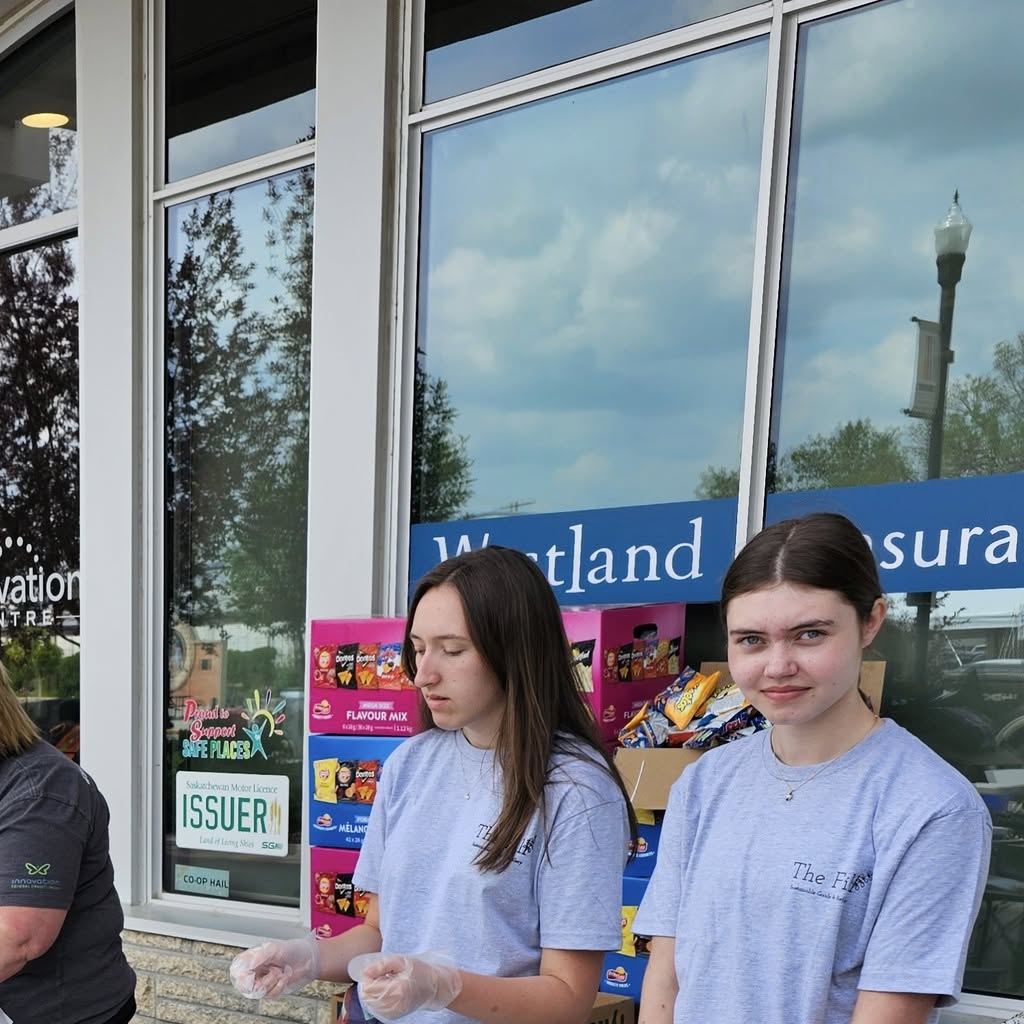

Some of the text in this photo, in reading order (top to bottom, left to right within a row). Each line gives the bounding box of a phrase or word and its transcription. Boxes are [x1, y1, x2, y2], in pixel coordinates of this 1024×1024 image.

[433, 517, 703, 593] Wtland
[863, 524, 1018, 570] sura
[184, 699, 230, 722] Proud to
[346, 711, 408, 721] FLAVOUR MIX
[190, 719, 236, 742] Support
[182, 739, 251, 760] SAFE PLACES
[186, 781, 278, 794] Saskatchewan Motor Licence
[183, 794, 267, 834] ISSUER
[183, 874, 229, 889] CO-OP HAIL
[793, 861, 825, 885] The
